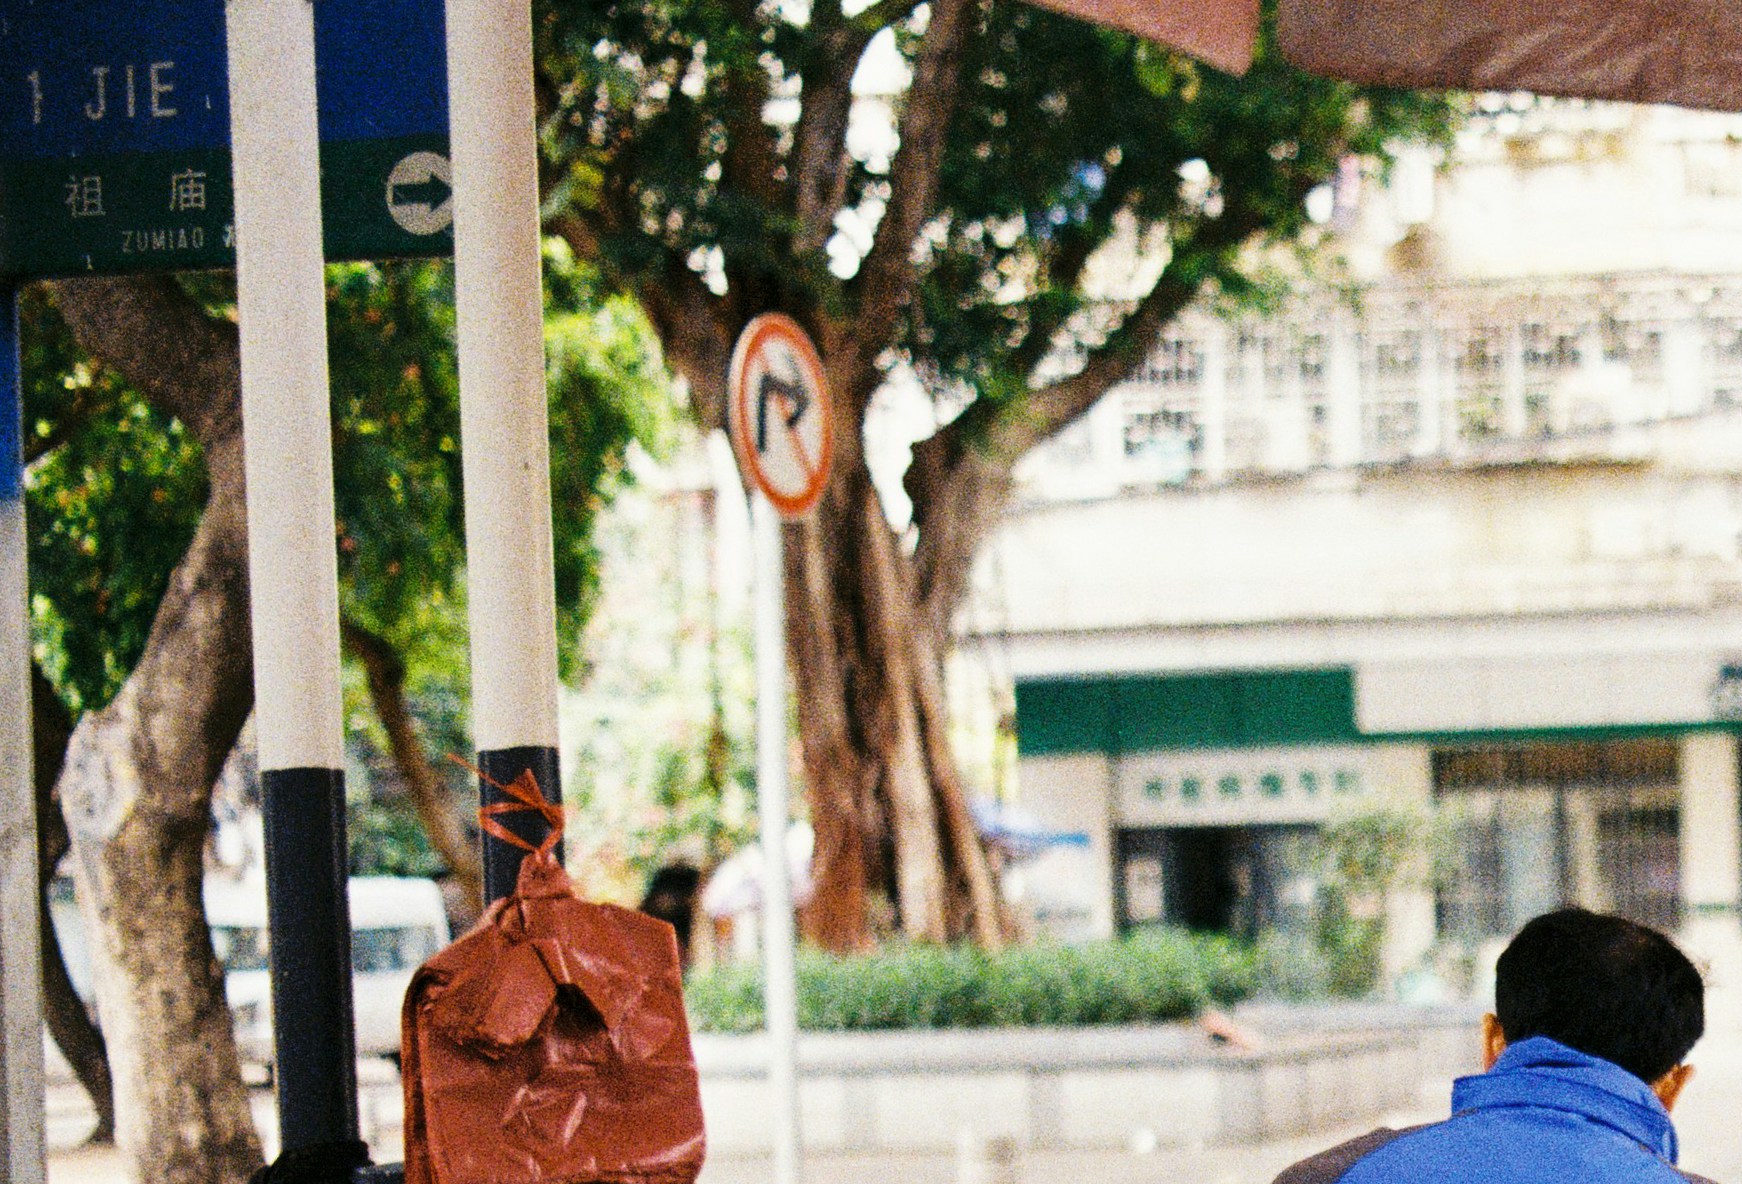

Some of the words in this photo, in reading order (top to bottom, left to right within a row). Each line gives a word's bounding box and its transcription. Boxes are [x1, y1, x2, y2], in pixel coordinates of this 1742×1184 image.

[85, 61, 178, 120] JIE
[65, 167, 206, 218] 祖庙
[121, 226, 204, 252] ZUMIAO
